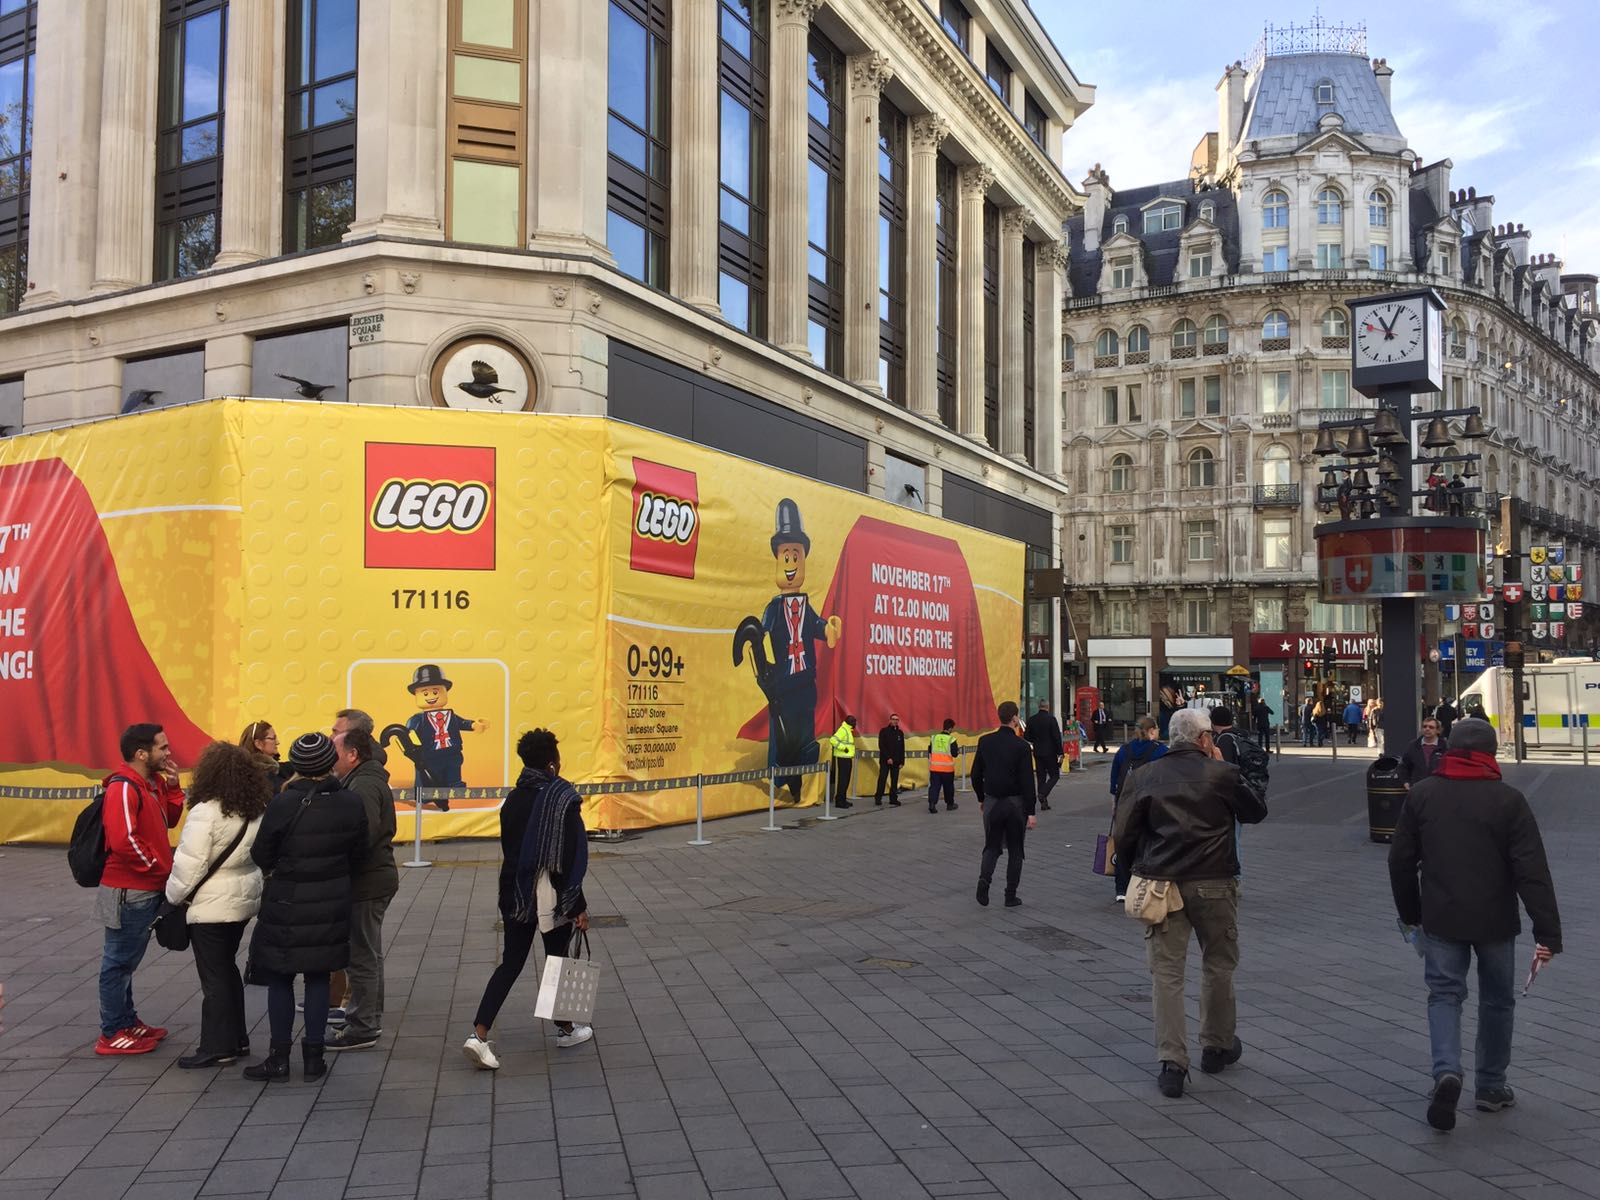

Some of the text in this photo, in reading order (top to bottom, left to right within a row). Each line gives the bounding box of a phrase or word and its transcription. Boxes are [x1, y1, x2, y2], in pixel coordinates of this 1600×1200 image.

[350, 313, 385, 327] LEICESTER
[352, 323, 381, 336] SQUARE
[373, 481, 488, 531] LEGO
[637, 493, 695, 543] LEGO
[872, 563, 951, 593] NOVEMBER 17TH
[391, 589, 471, 609] 171116
[874, 594, 950, 622] AT 12.00 NOON
[869, 624, 953, 650] JOIN US FOR THE
[1299, 638, 1328, 655] PRET
[1330, 638, 1339, 655] A
[627, 644, 685, 678] 0-99+
[866, 654, 956, 677] STORE UNBOXING!
[627, 684, 659, 700] 171116
[648, 708, 666, 719] Store
[626, 723, 679, 736] Leicester Square
[626, 744, 643, 754] OVER
